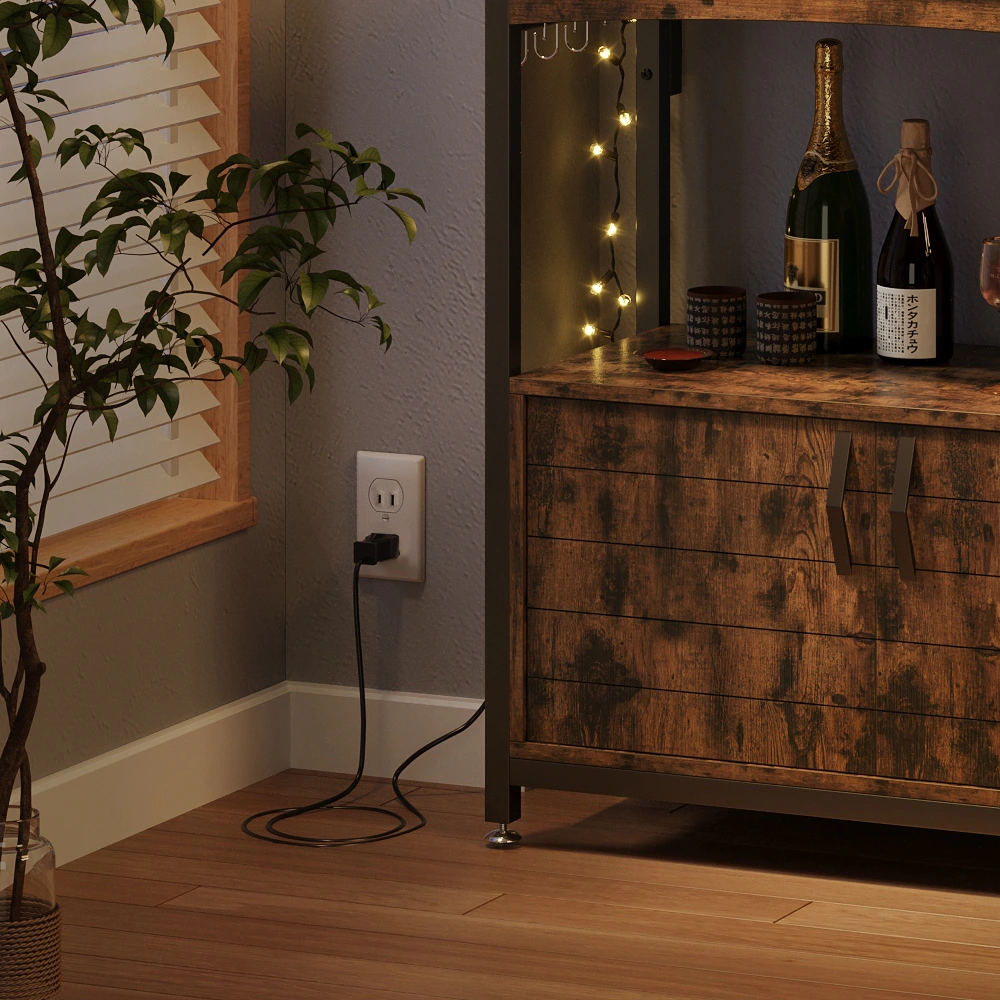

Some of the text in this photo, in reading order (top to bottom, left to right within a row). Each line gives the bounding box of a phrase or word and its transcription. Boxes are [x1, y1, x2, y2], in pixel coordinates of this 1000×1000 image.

[906, 294, 919, 354] ホンタカチュウ
